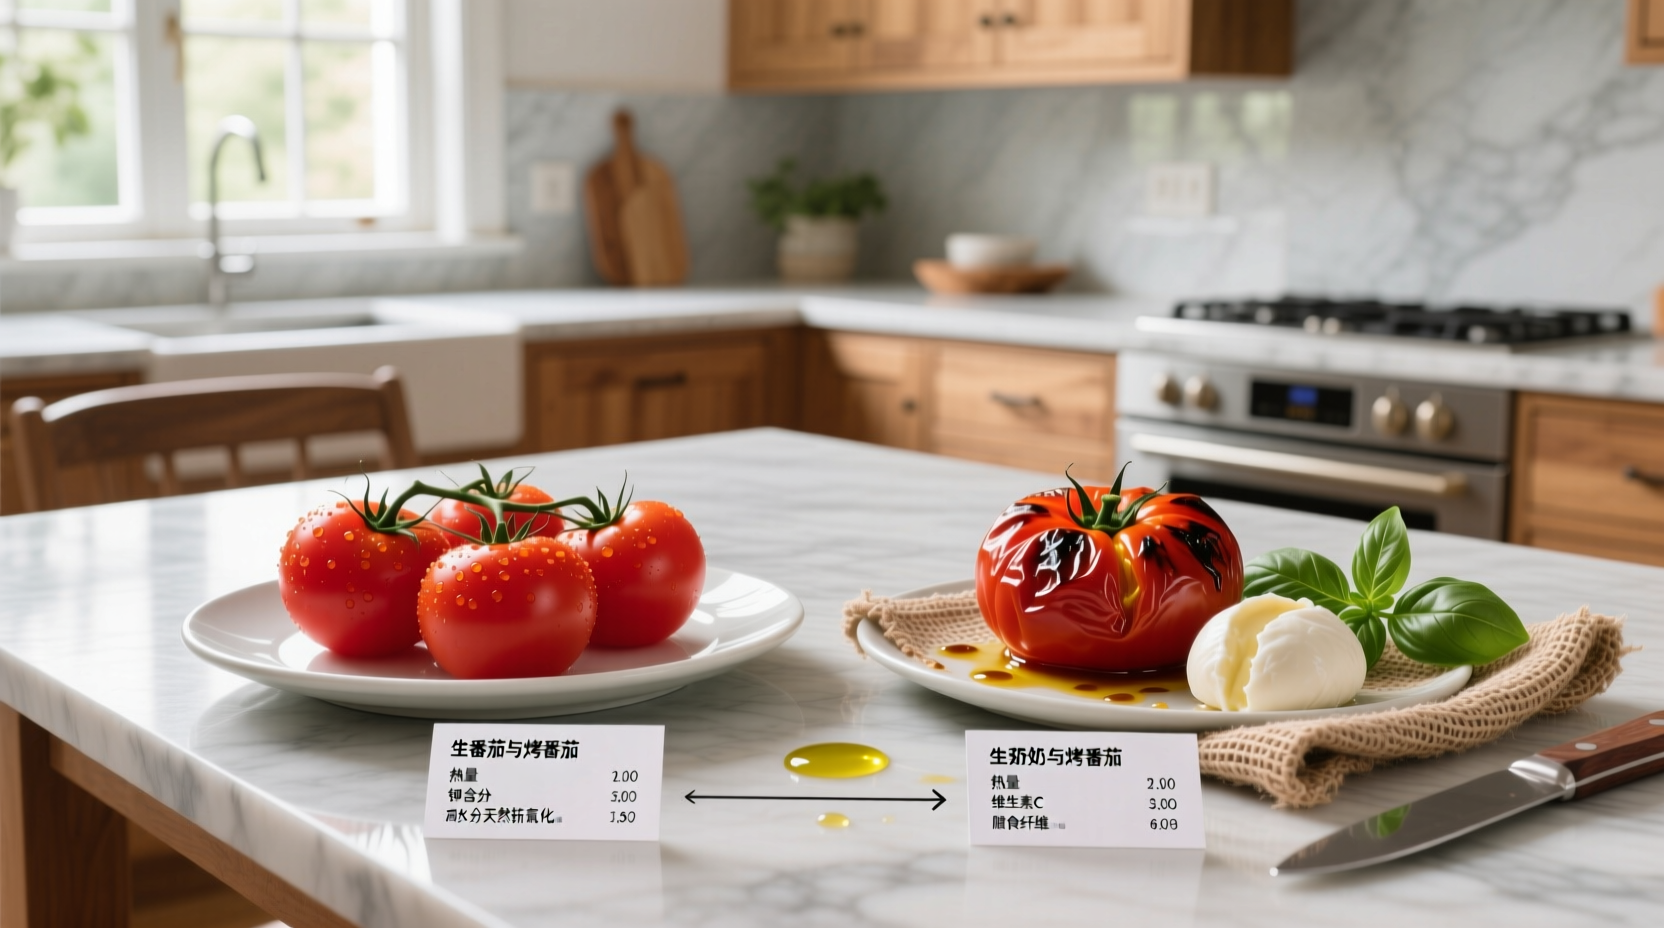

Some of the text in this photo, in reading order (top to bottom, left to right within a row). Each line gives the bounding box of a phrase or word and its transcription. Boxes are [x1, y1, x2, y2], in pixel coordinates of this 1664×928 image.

[450, 738, 580, 759] 生番茄与烤番茄
[1146, 777, 1176, 790] 2.00
[991, 794, 1044, 809] 维生素C
